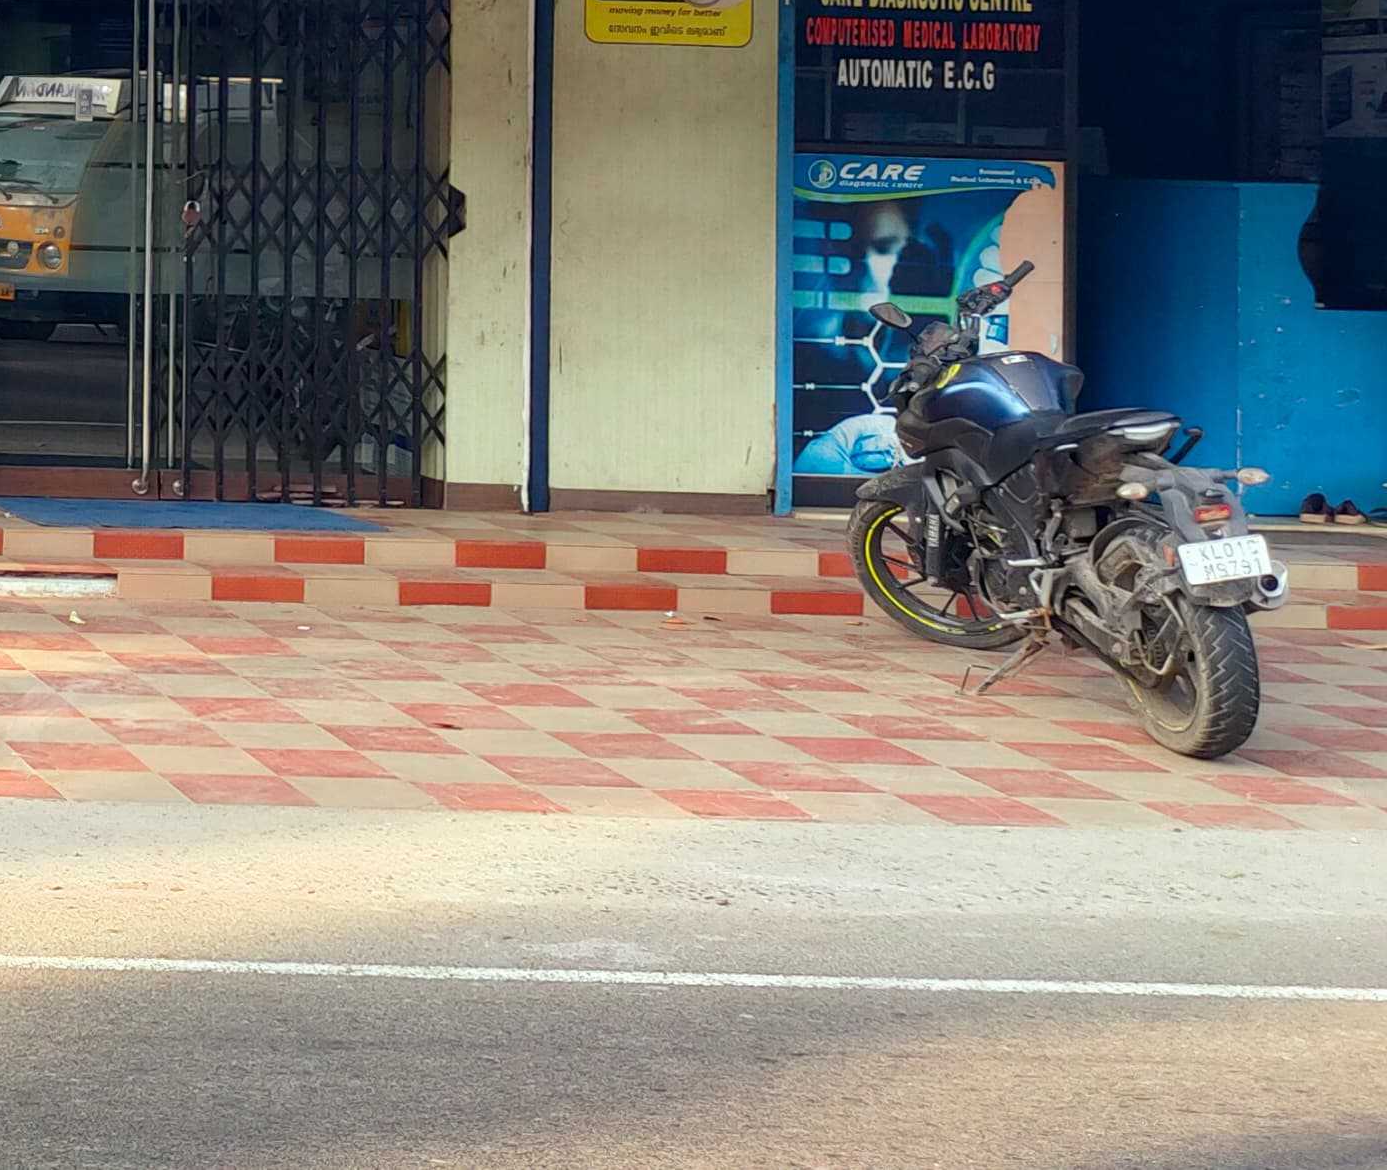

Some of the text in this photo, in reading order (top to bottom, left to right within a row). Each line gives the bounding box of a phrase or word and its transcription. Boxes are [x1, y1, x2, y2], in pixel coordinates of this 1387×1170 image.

[608, 6, 722, 17] moving money for better
[806, 16, 1041, 52] COMPUTERISED MEDICAL LABORATORY
[837, 59, 995, 90] AUTOMATIC E.C.G
[839, 162, 925, 181] CARE
